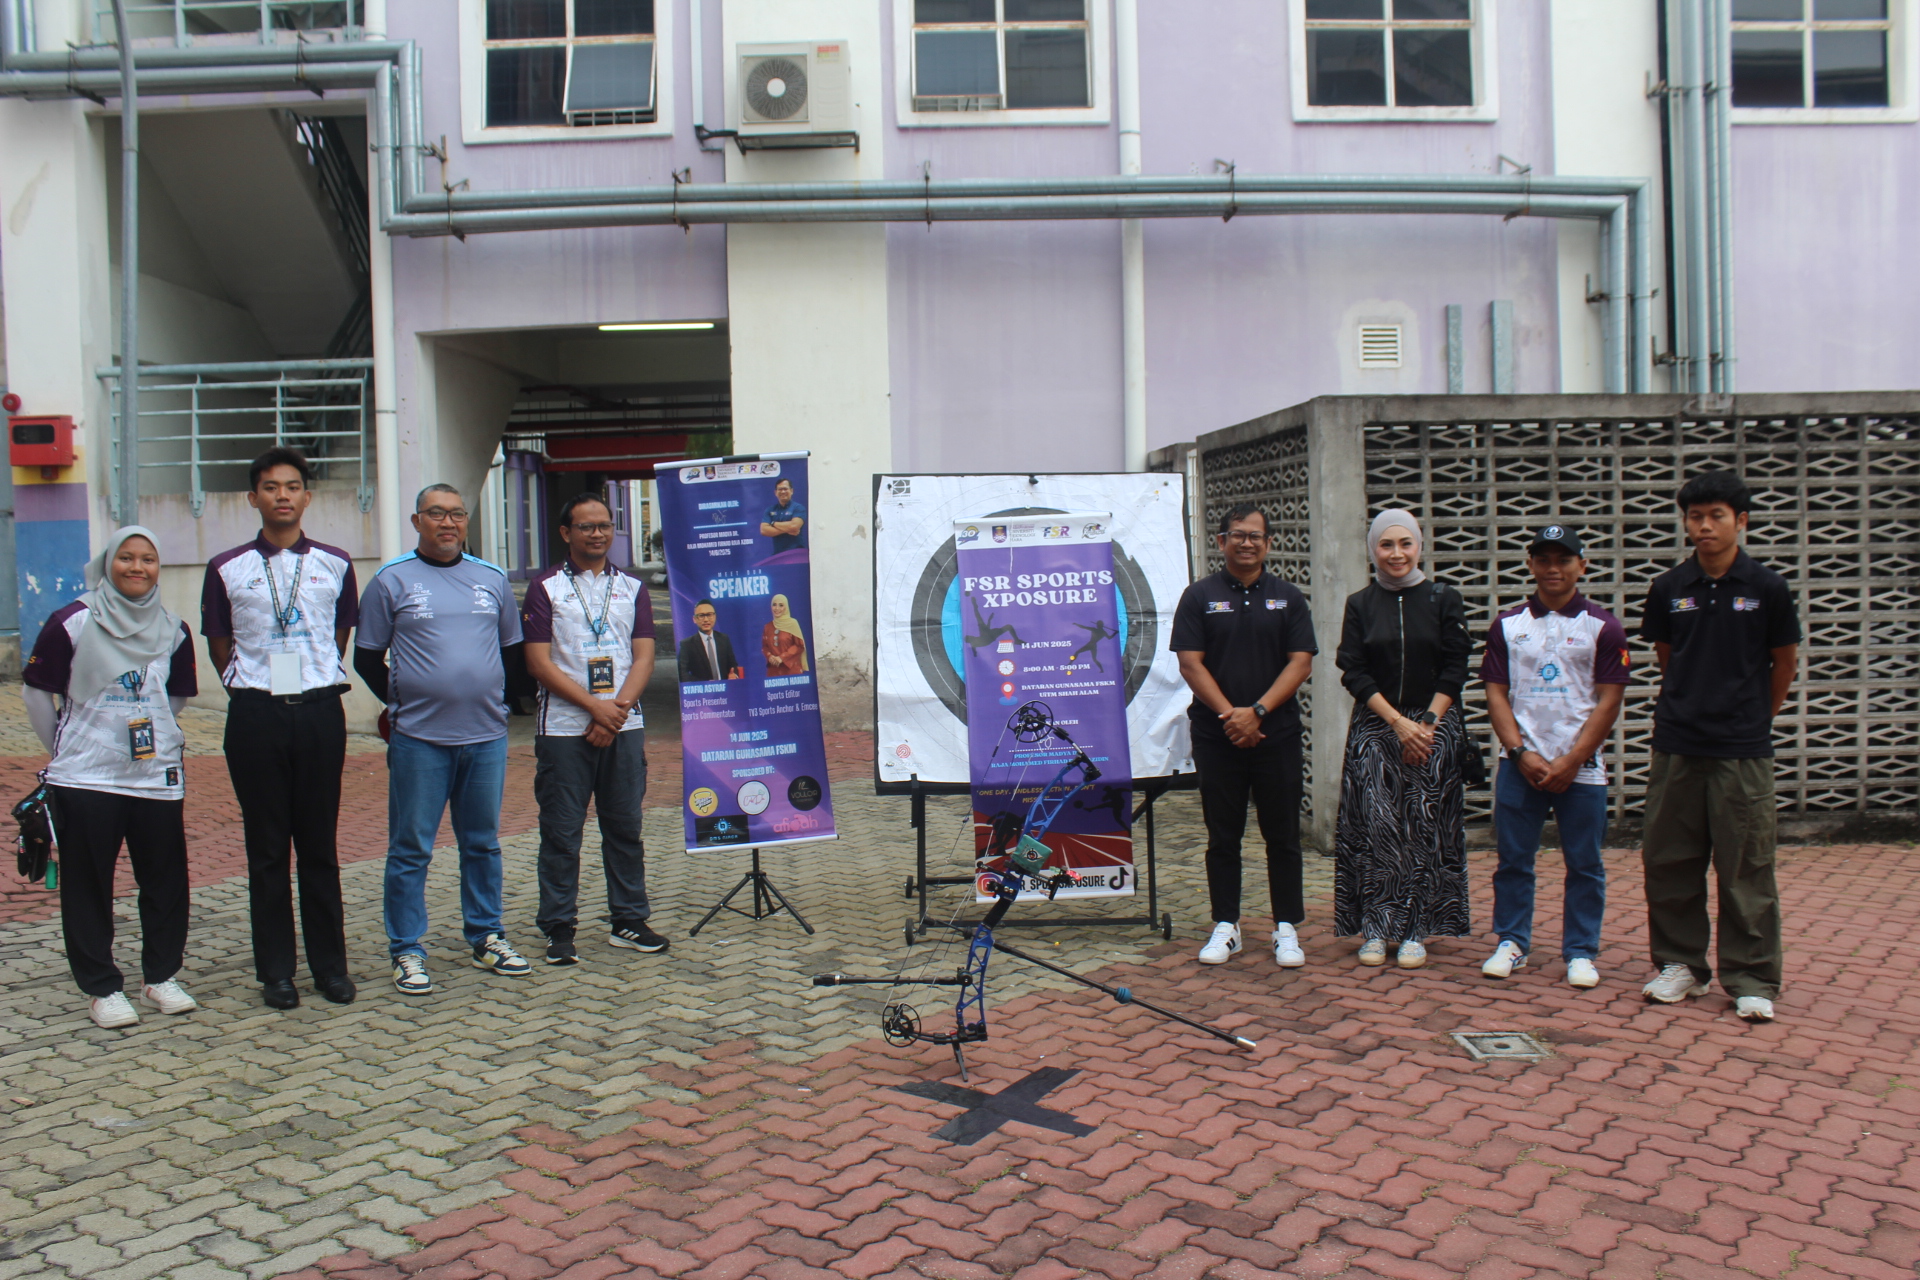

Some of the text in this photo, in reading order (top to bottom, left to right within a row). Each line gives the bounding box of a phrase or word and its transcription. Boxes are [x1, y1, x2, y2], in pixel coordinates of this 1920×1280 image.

[738, 464, 757, 473] FSR
[1043, 525, 1070, 538] FSR
[709, 575, 770, 599] SPEAKER
[964, 570, 1114, 592] FSR SPORTS
[982, 588, 1098, 608] XPOSURE
[1031, 641, 1050, 649] JUN
[1051, 640, 1072, 648] 2025
[683, 685, 704, 695] SYAFIQ
[1021, 683, 1055, 691] DATARAN
[1055, 681, 1095, 689] GUNASAMA
[767, 689, 800, 701] Sports Editor
[683, 697, 728, 708] Sports Presenter
[748, 708, 758, 717] TV3
[759, 706, 775, 716] Sports
[776, 704, 794, 714] Anchor
[801, 702, 818, 711] Emcee
[682, 712, 699, 722] Sports
[730, 730, 768, 742] 14 JUN 2025
[701, 743, 797, 762] DATARAN GUNASAMA FSKM
[731, 765, 775, 778] SPONSORED BY:
